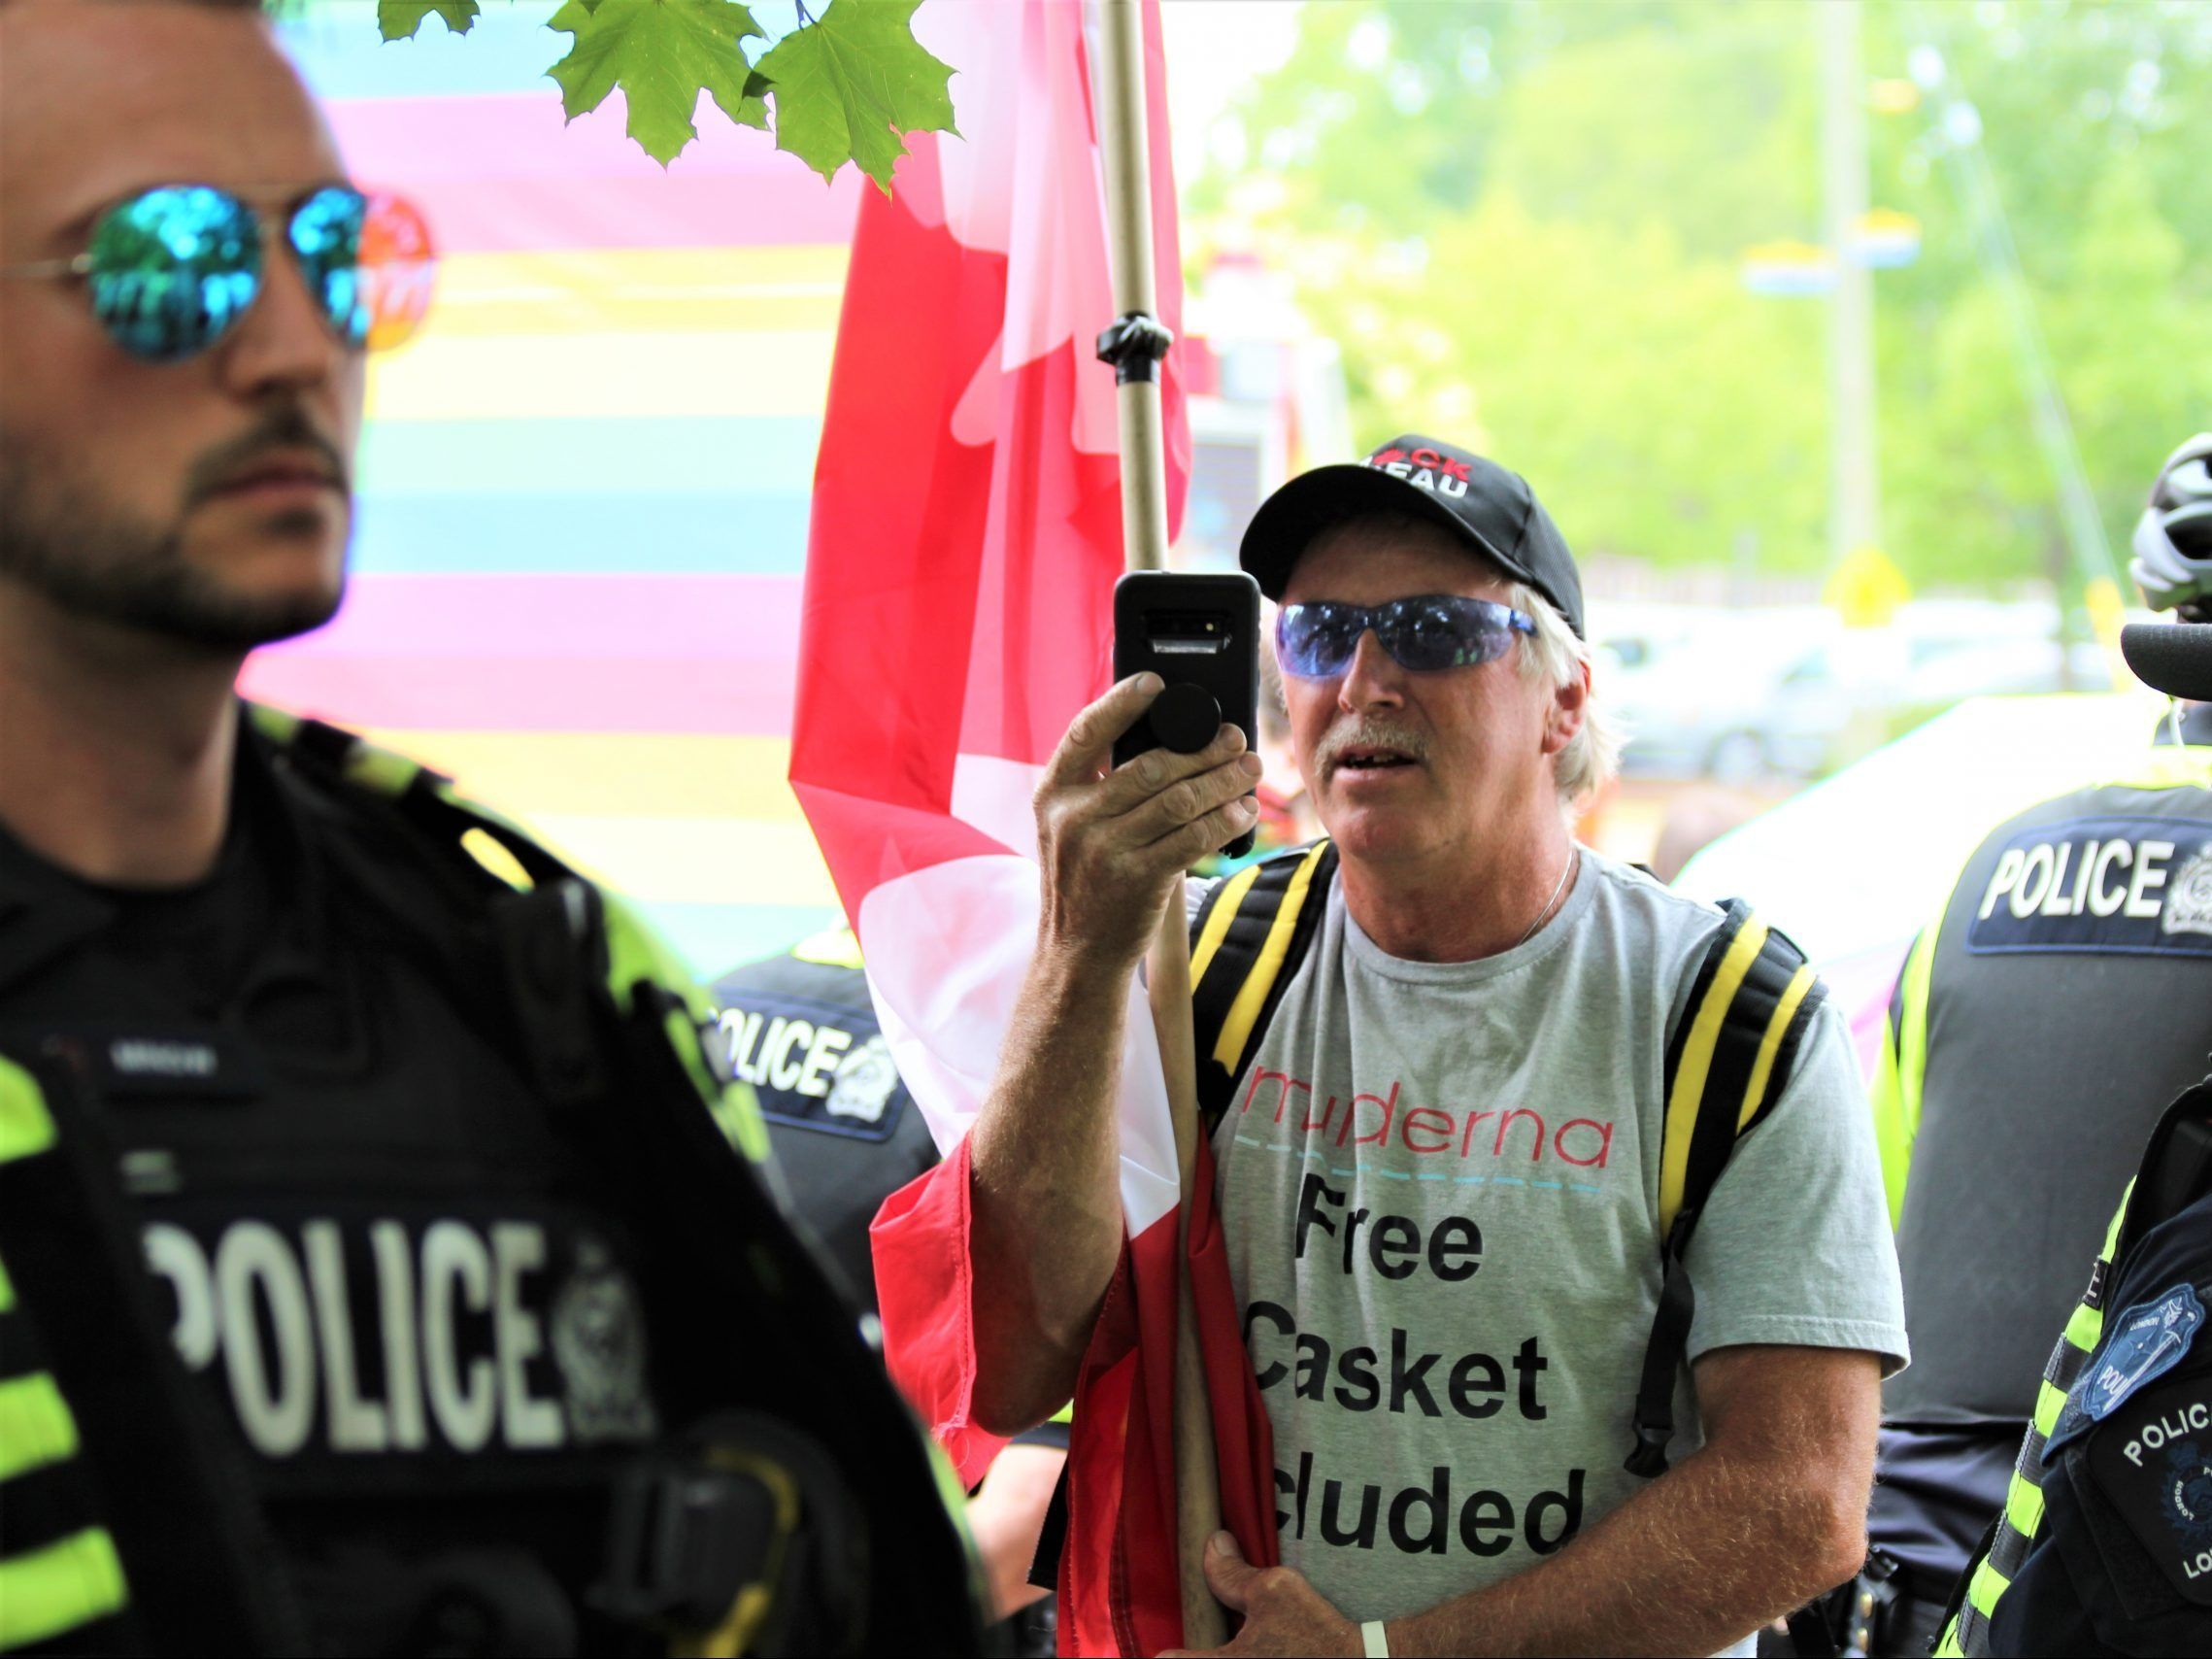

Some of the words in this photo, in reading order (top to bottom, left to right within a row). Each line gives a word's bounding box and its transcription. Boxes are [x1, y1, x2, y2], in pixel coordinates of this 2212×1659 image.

[1977, 838, 2175, 920] POLICE
[708, 1006, 853, 1098] OLICE
[1295, 1172, 1484, 1282] Free
[1243, 1301, 1549, 1421] Casket
[2123, 1403, 2212, 1468] POLIC
[2183, 1548, 2212, 1580] LO
